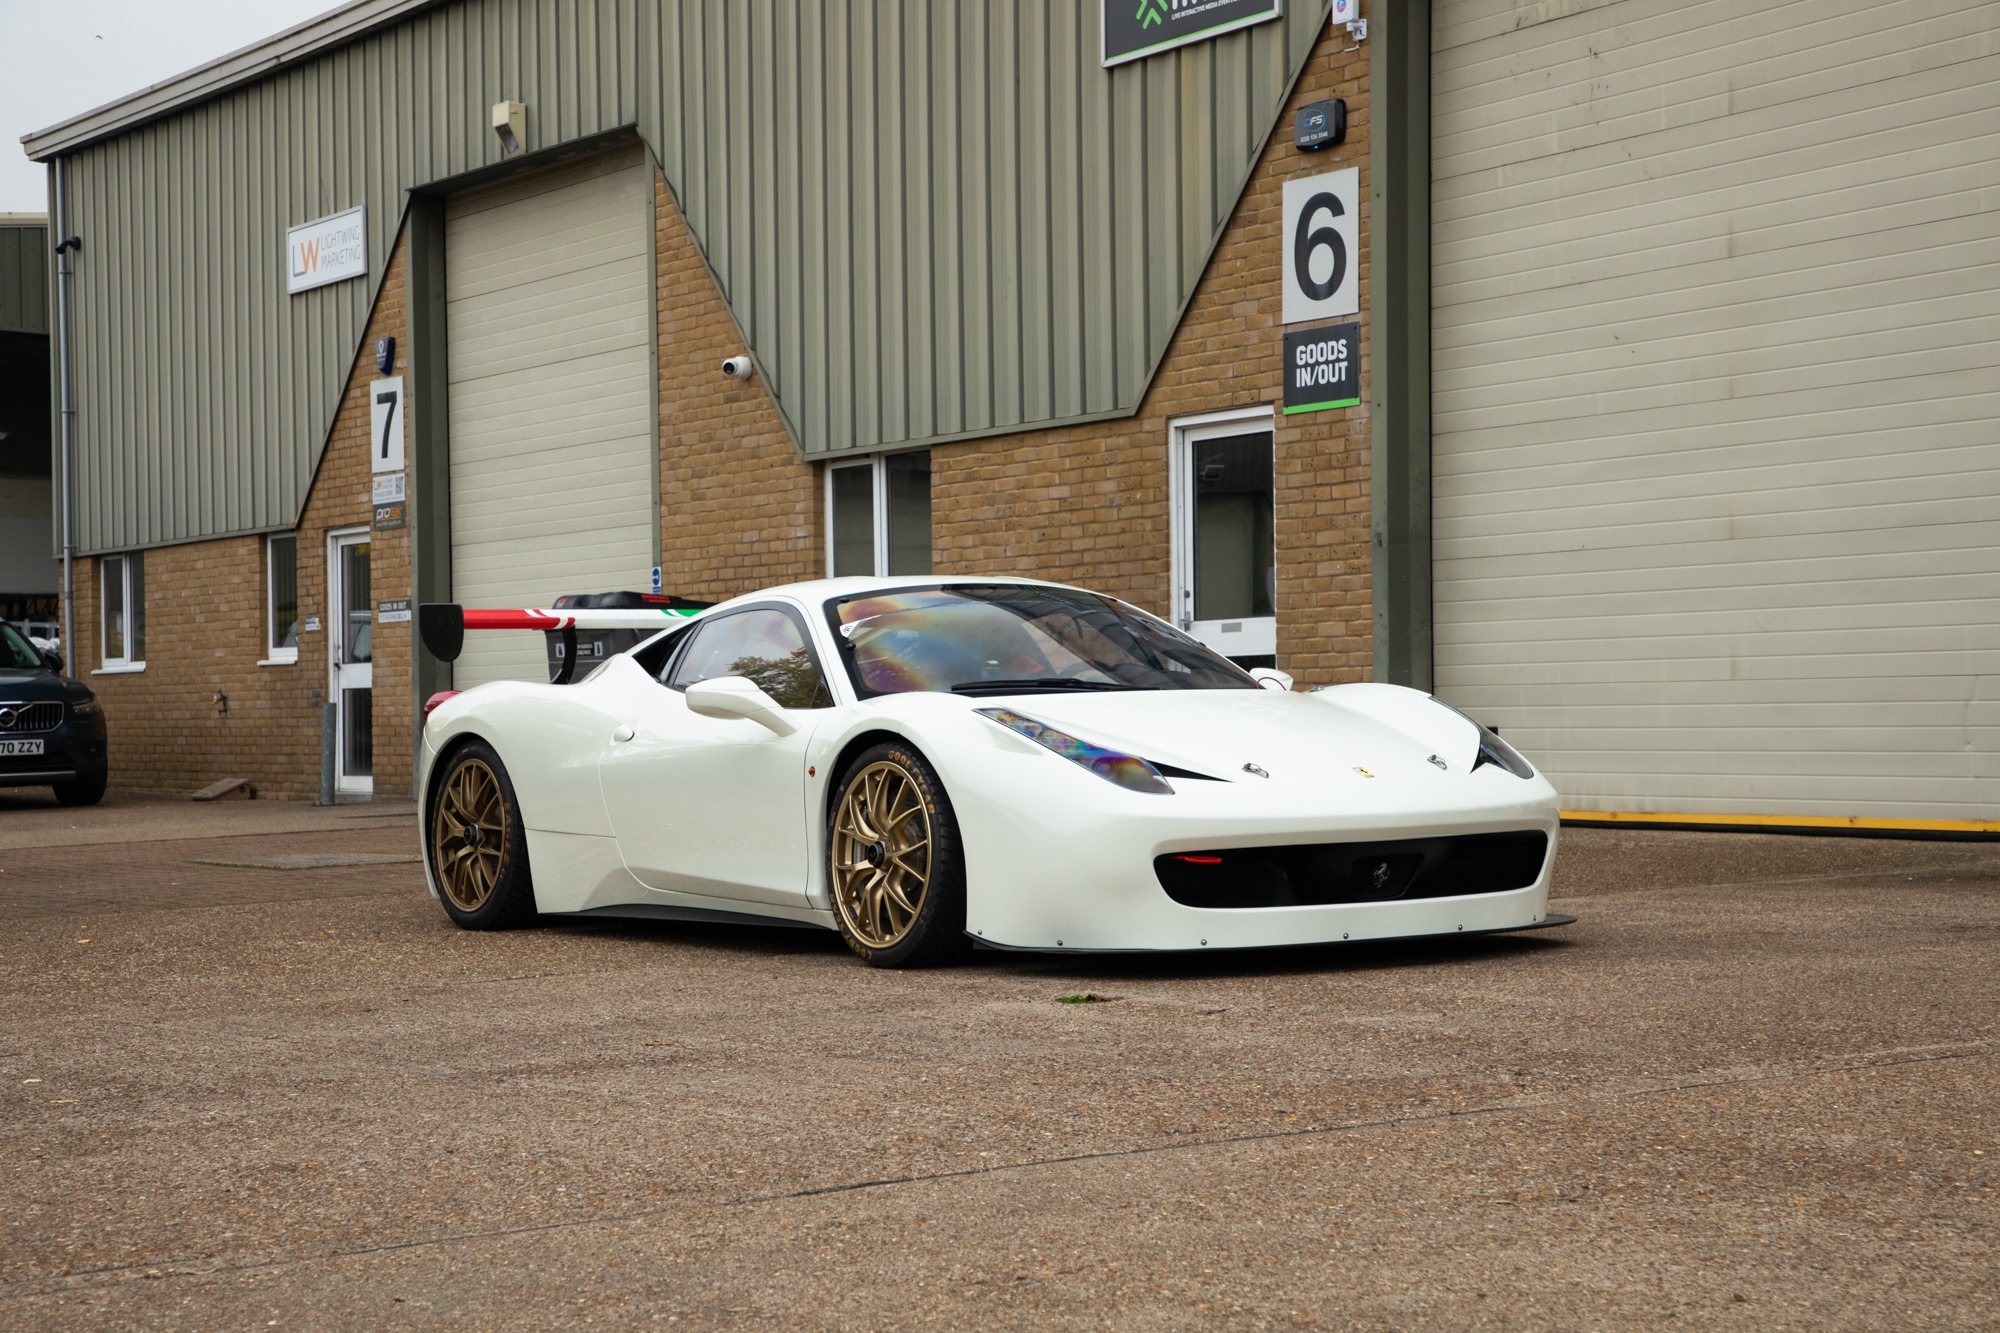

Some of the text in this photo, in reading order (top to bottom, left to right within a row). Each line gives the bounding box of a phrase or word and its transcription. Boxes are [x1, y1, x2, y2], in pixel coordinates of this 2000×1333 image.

[1172, 12, 1181, 20] LIVE
[1181, 5, 1205, 18] INTERACTIVE
[1205, 2, 1218, 11] MEDIA
[321, 224, 359, 251] LIGHTWING
[1294, 191, 1347, 301] 6
[321, 244, 361, 270] MARKETING
[1296, 339, 1348, 366] GOODS
[1296, 361, 1348, 388] IN/OUT
[377, 391, 397, 458] 7
[379, 602, 392, 611] GOODS
[398, 601, 407, 610] OUT
[18, 741, 42, 753] ZZY
